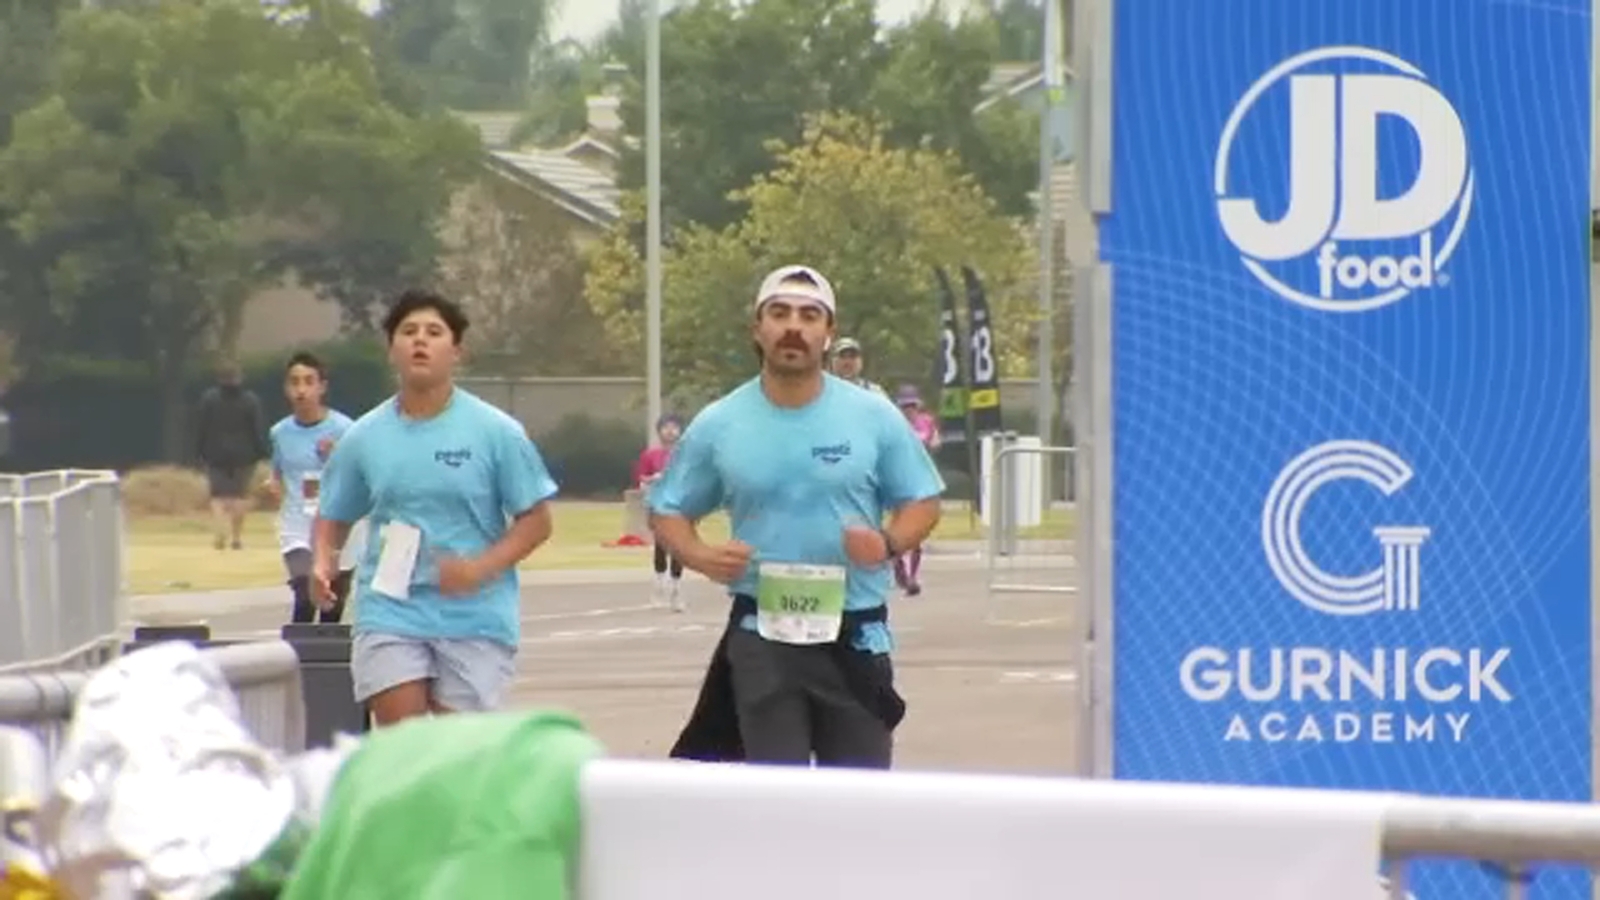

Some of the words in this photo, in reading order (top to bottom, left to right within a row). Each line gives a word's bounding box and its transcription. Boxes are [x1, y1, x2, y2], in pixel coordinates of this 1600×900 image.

[1217, 73, 1468, 261] JD
[1317, 231, 1432, 298] food
[1179, 646, 1513, 703] GURNICK
[1223, 712, 1471, 744] ACADEMY
